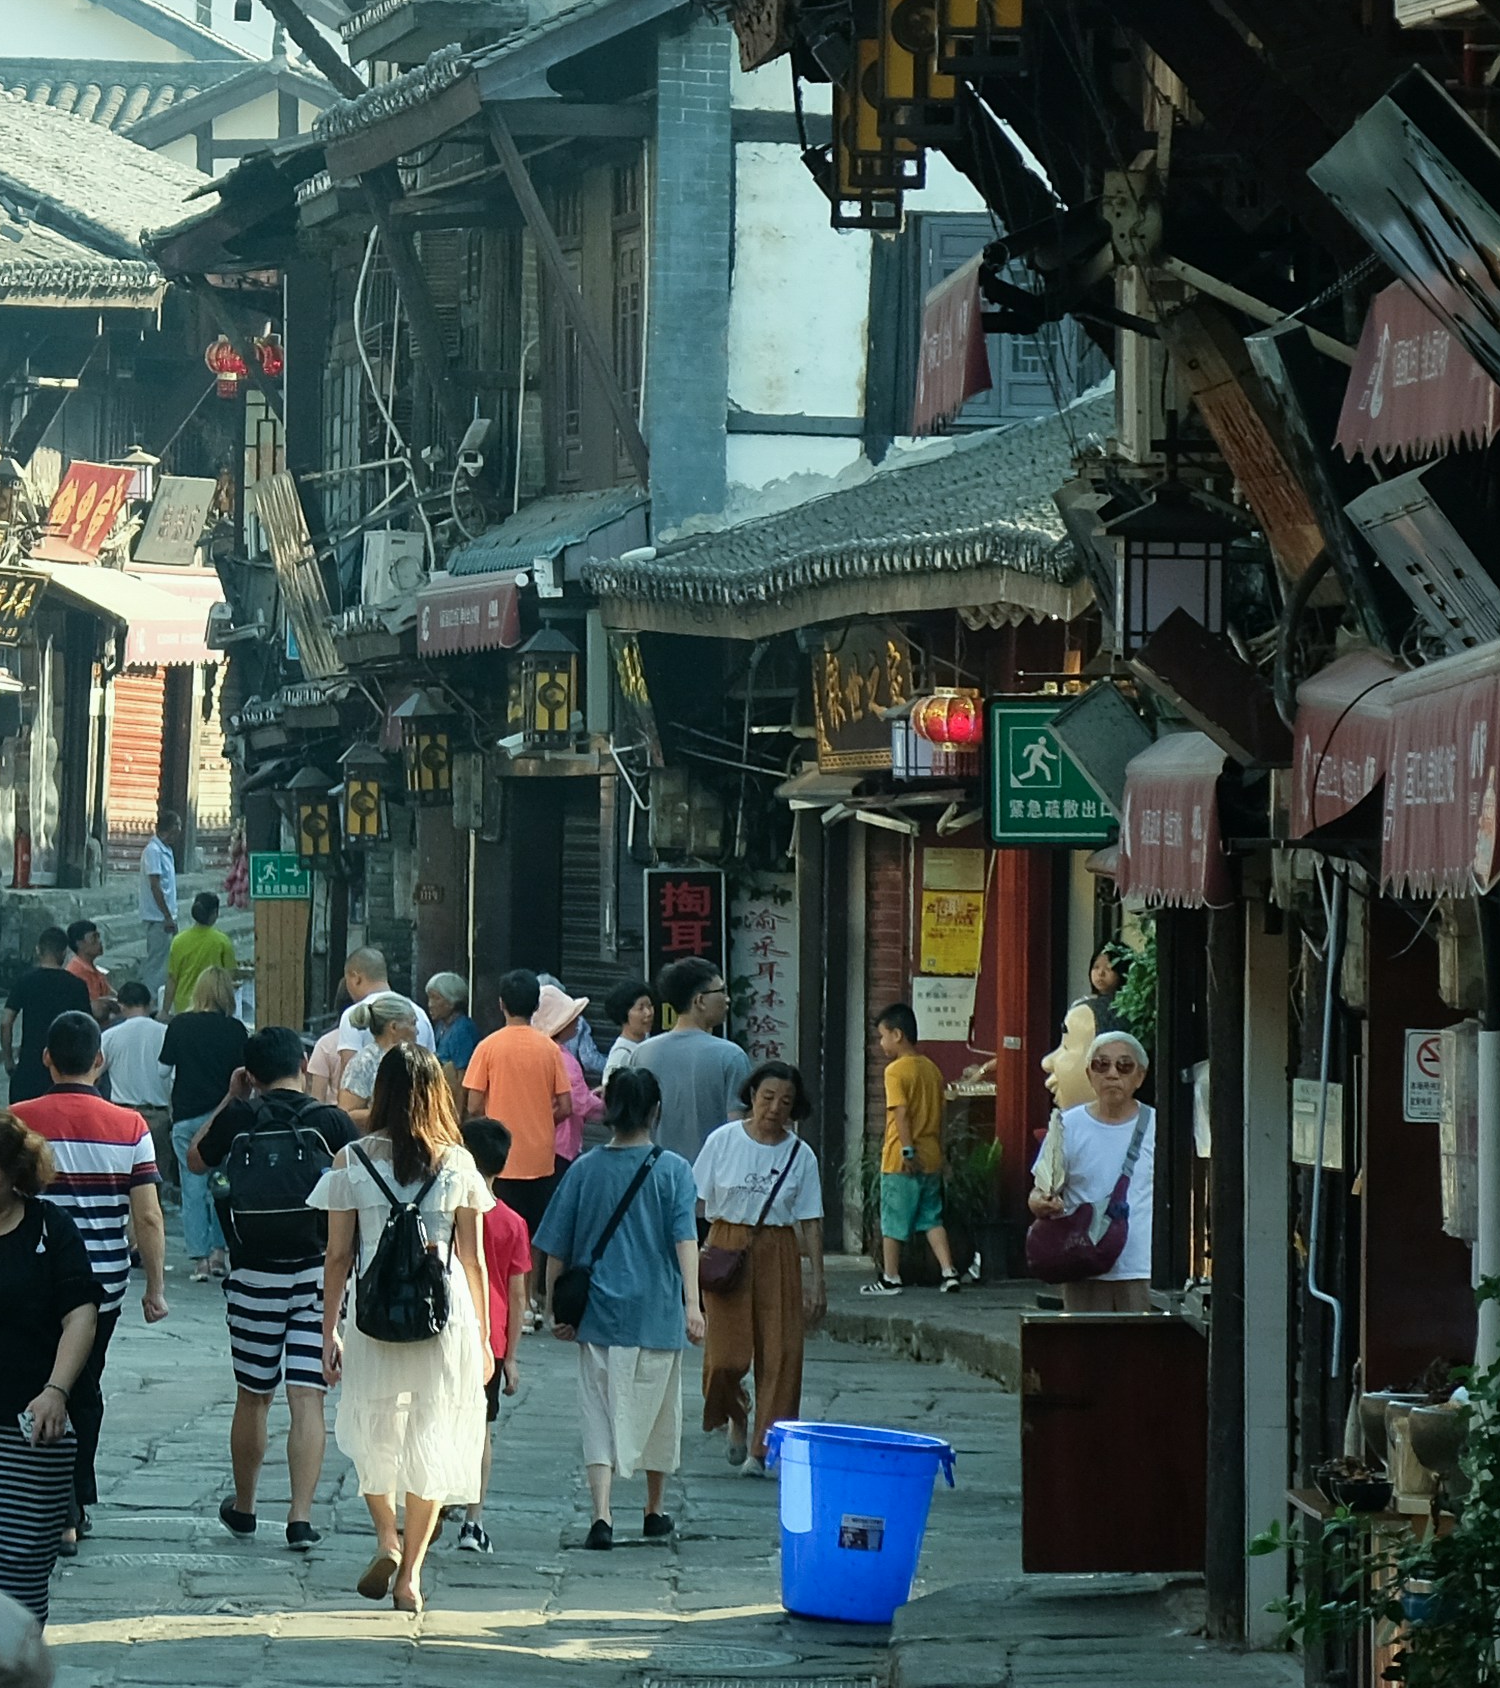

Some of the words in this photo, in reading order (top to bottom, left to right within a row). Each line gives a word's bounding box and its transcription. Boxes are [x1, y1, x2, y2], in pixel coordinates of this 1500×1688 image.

[1009, 798, 1115, 820] 紧急疏散出口
[743, 908, 791, 1059] 渝采耳体验馆
